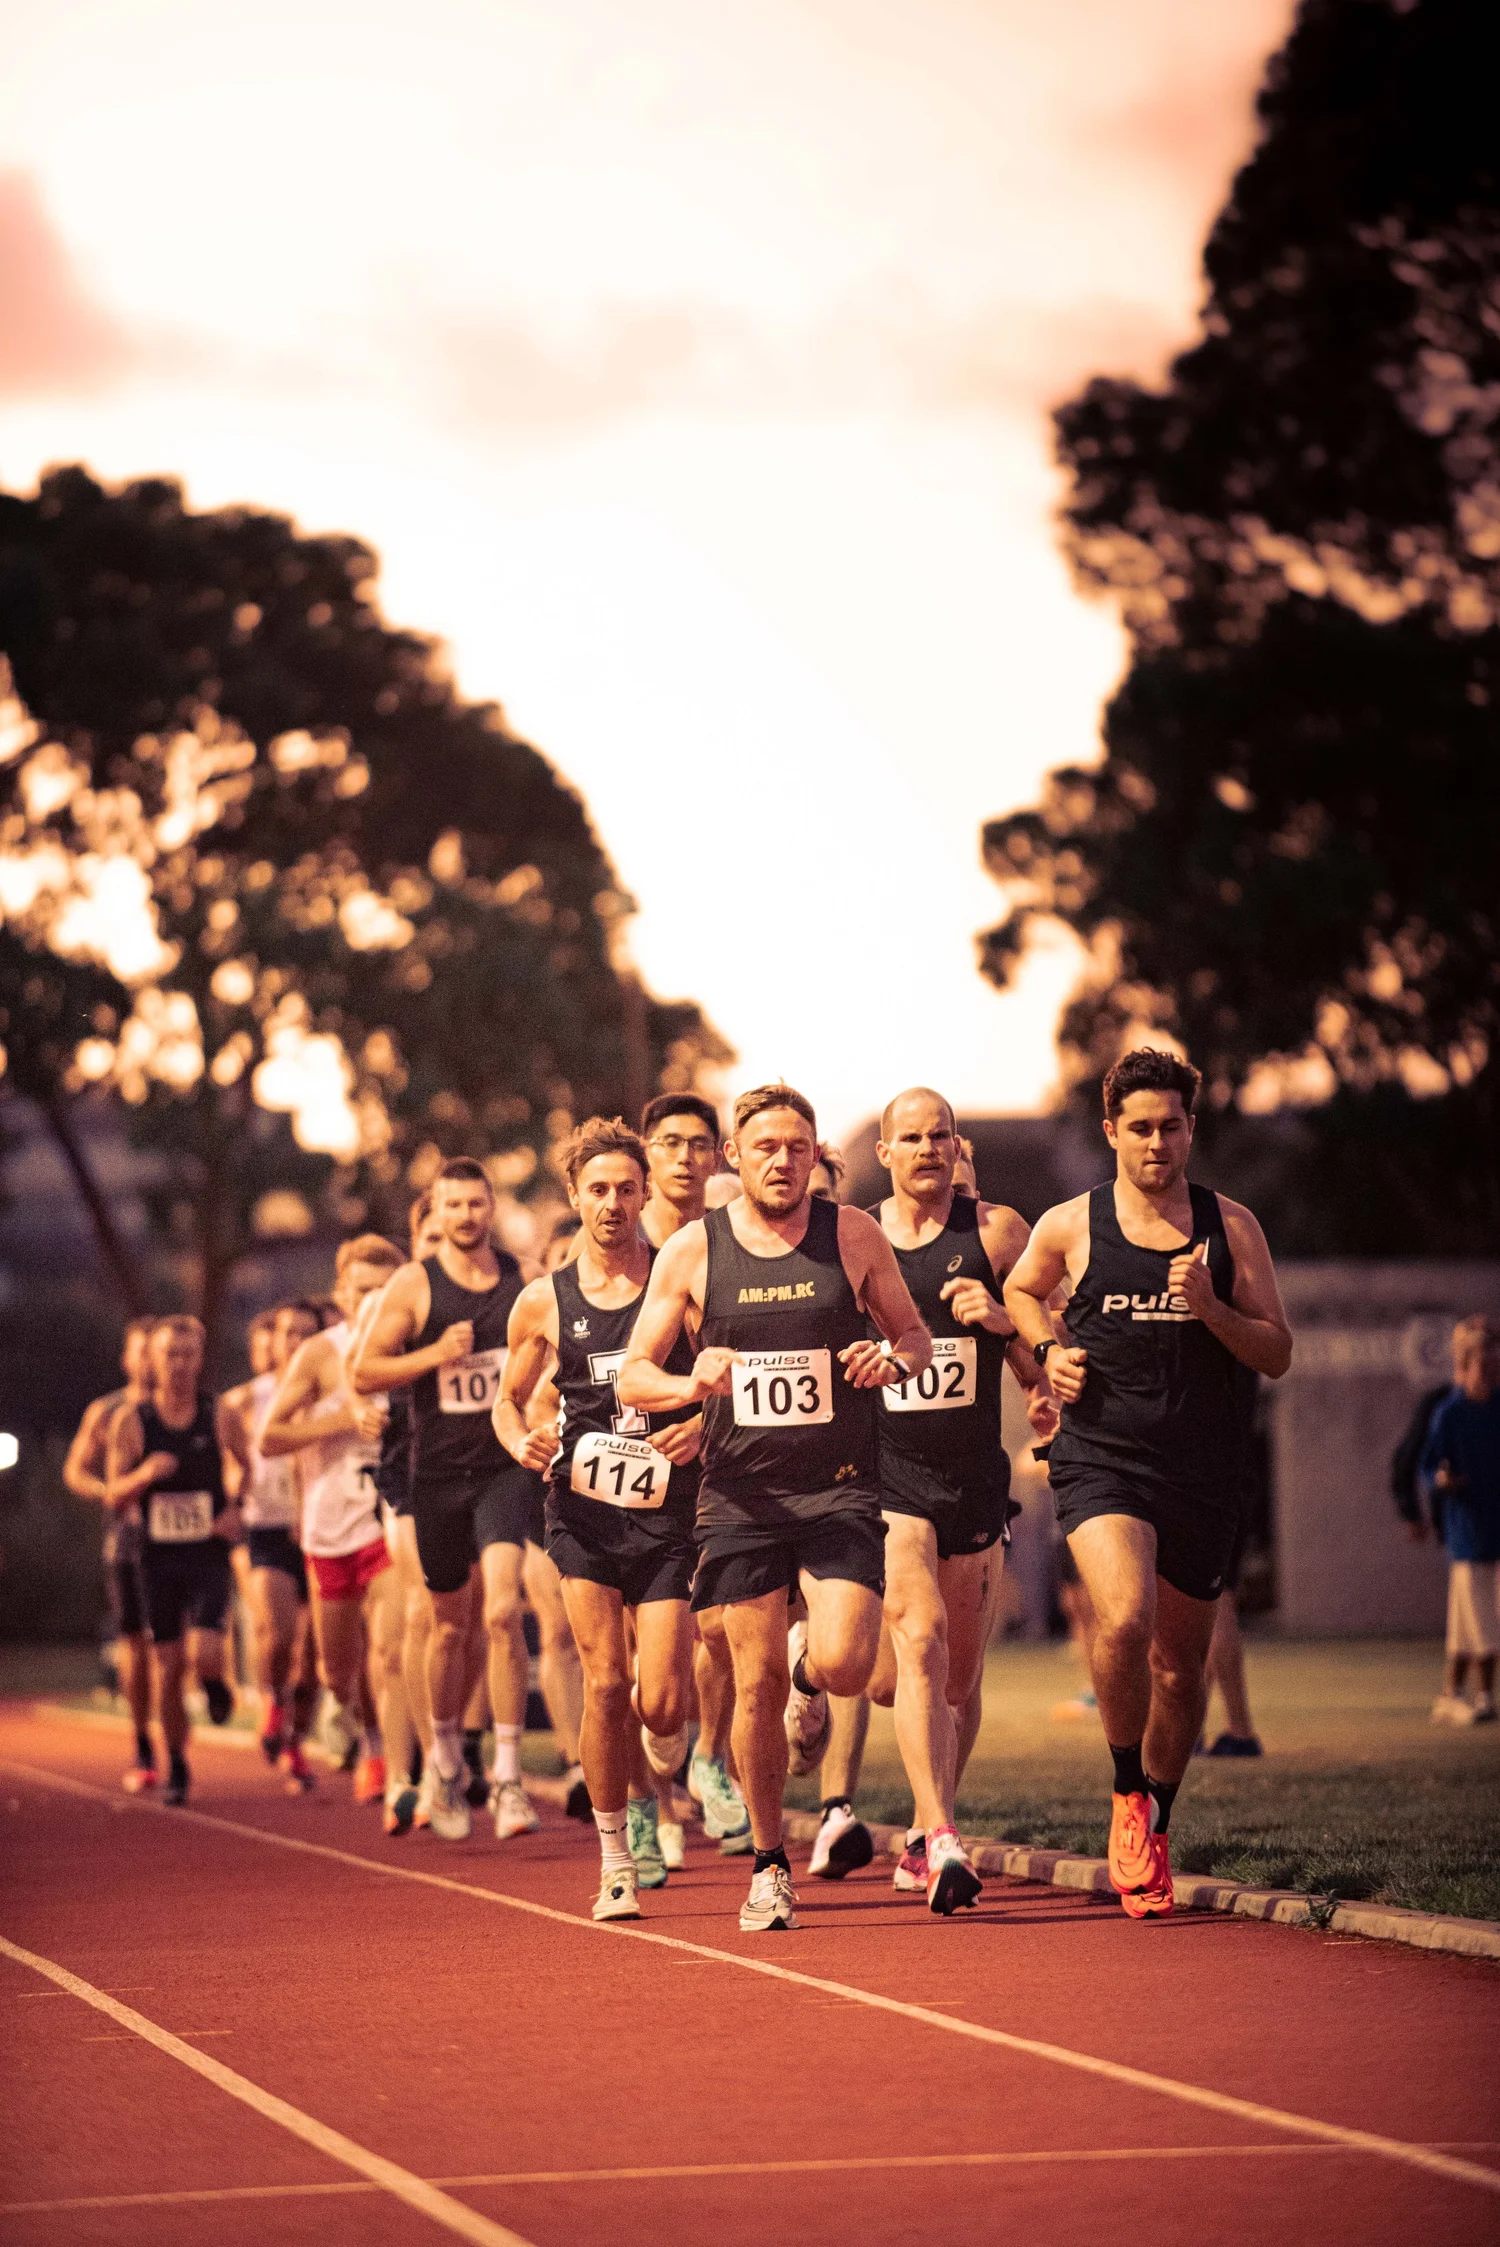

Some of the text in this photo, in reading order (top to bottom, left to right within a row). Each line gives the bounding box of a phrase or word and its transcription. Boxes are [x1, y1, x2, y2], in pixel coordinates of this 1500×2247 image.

[738, 1281, 815, 1303] AM:PM.RC
[1102, 1292, 1190, 1313] puls
[748, 1355, 809, 1367] pulse
[744, 1374, 820, 1415] 103
[594, 1438, 652, 1456] pulse
[584, 1456, 655, 1501] 114
